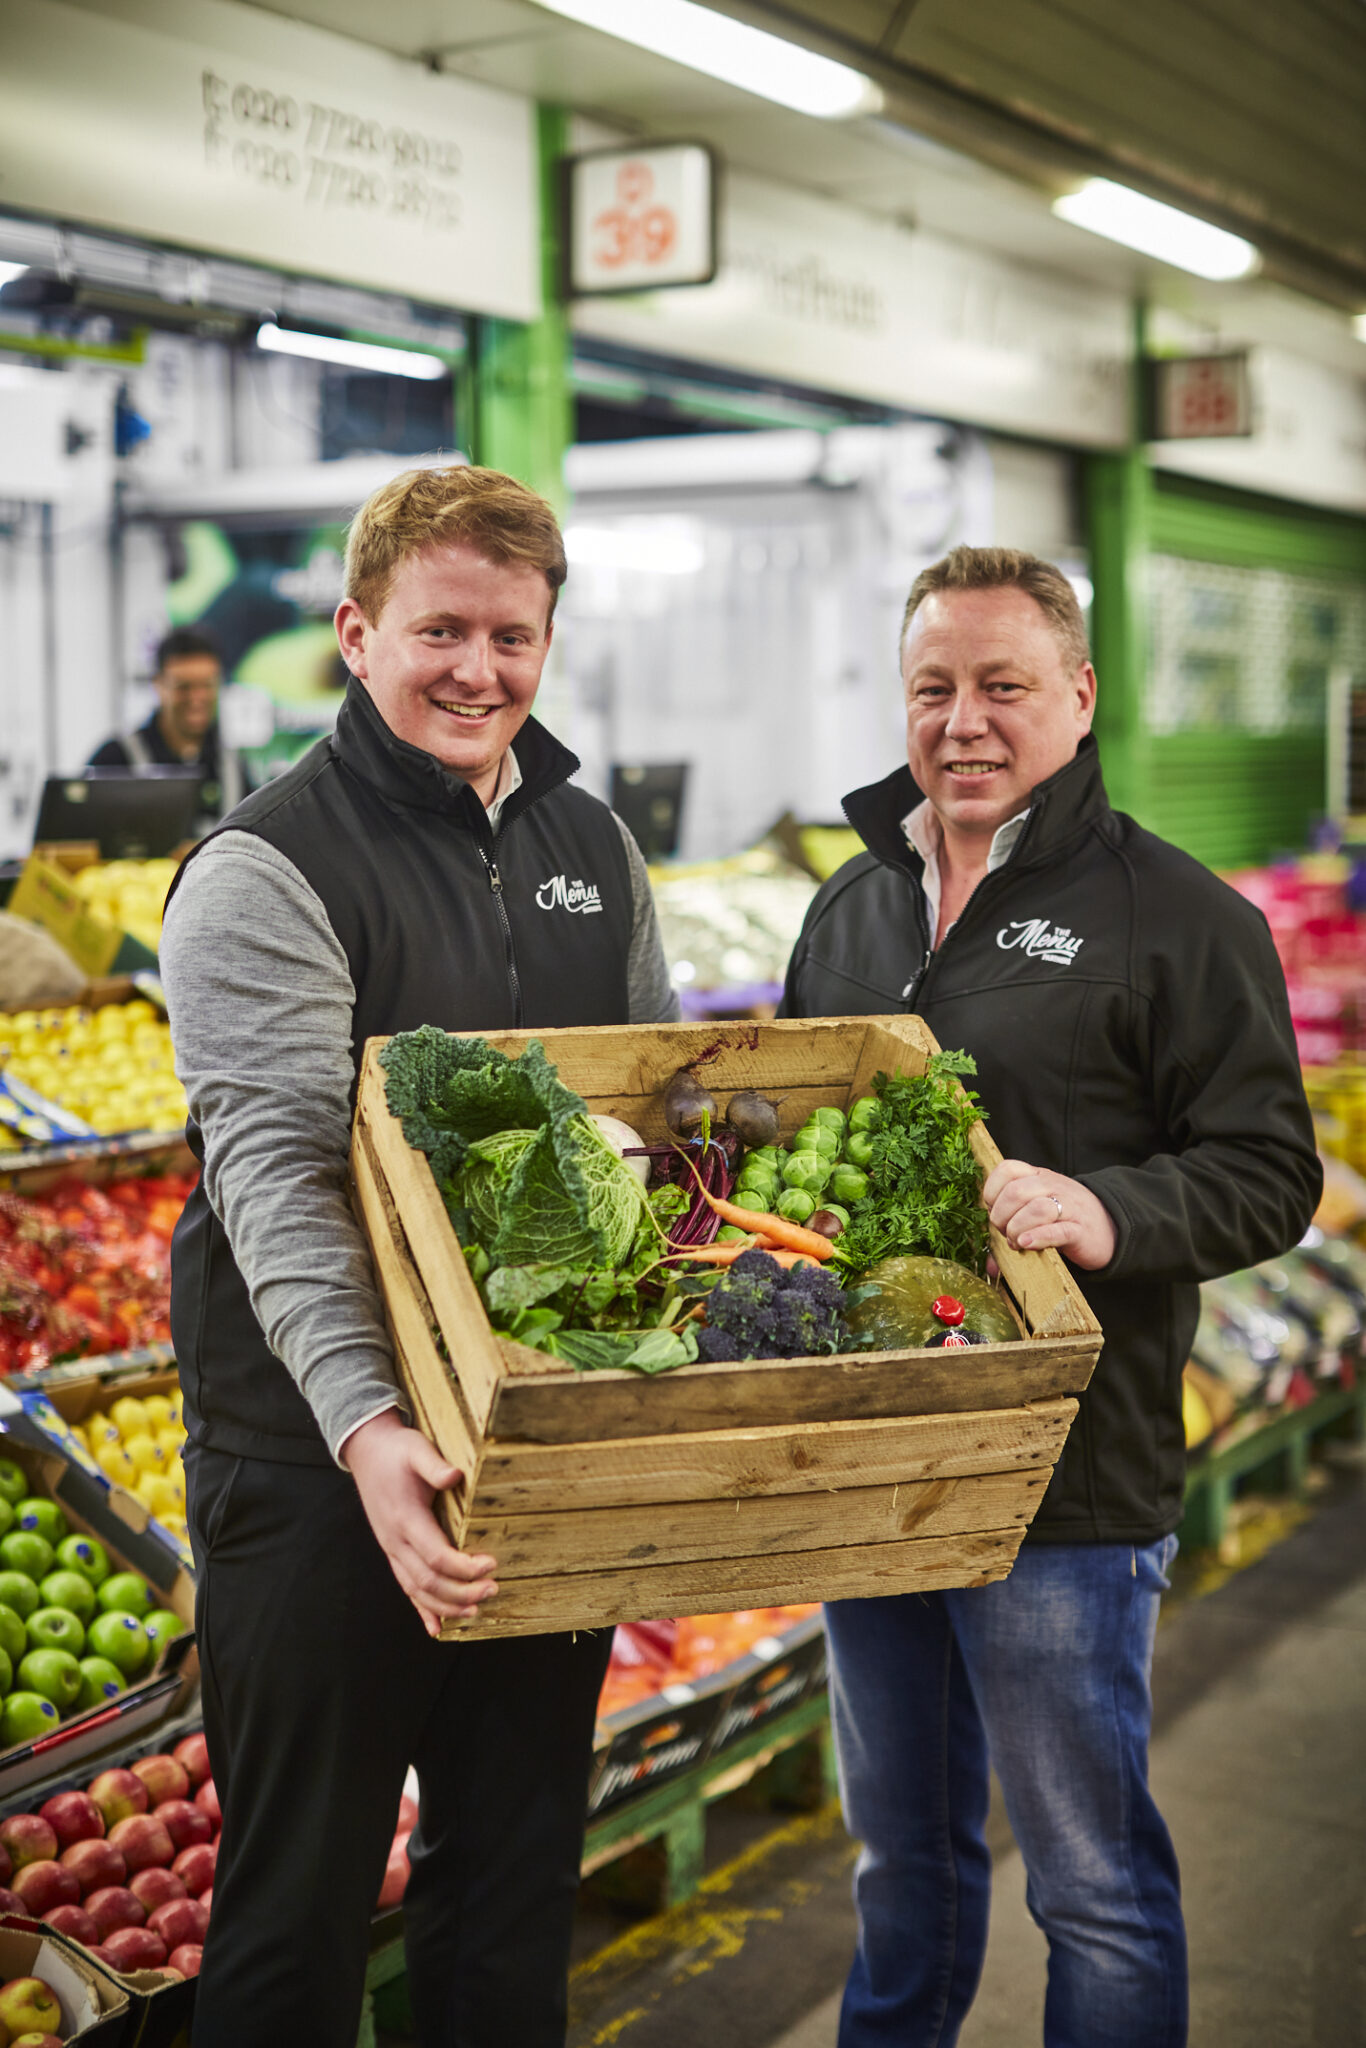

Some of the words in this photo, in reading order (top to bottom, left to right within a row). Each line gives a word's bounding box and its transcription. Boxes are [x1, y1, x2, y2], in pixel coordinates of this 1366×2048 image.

[592, 205, 679, 269] 39
[535, 874, 601, 913] Menu
[996, 918, 1084, 957] Menu
